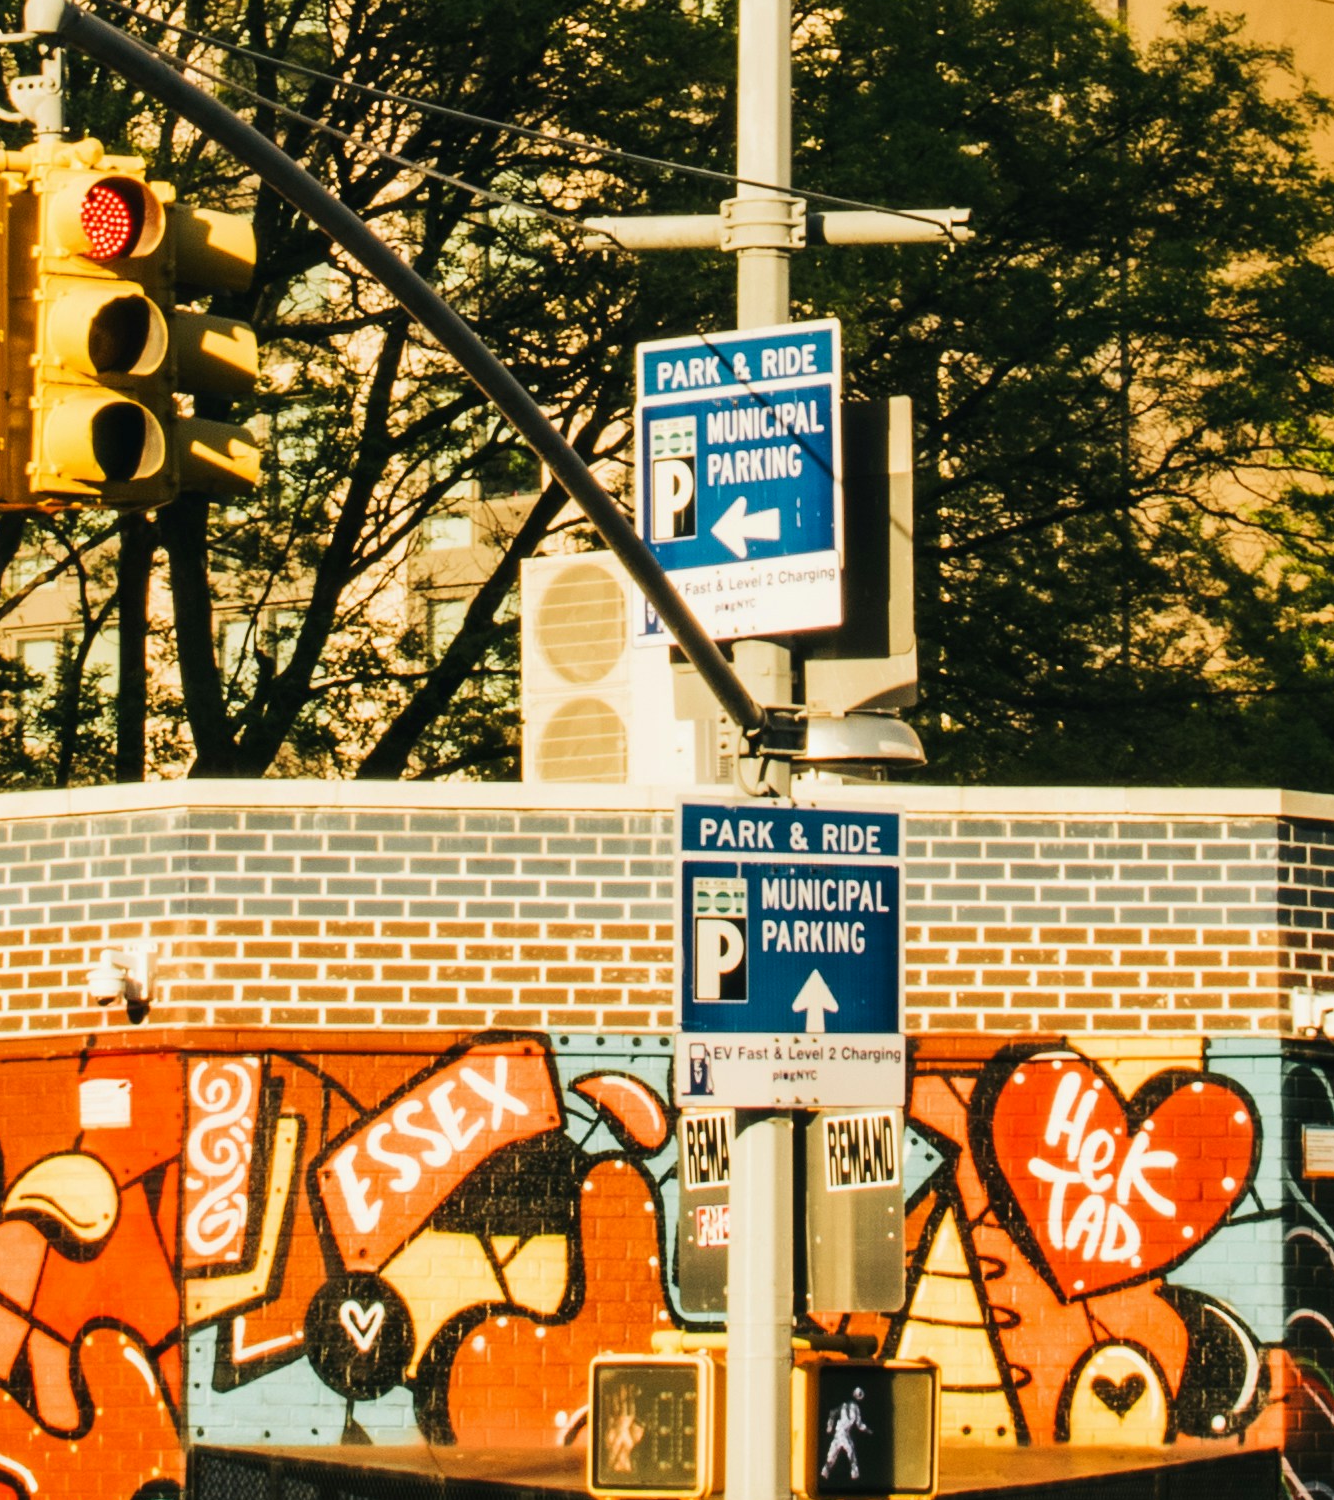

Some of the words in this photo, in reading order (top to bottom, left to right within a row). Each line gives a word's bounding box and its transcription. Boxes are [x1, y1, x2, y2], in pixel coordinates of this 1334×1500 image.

[657, 355, 721, 391] PARK
[732, 352, 752, 381] &
[761, 343, 818, 378] RIDE
[707, 400, 824, 446] MUNICIPAL
[707, 443, 803, 487] PARKING
[684, 581, 711, 597] Fast
[716, 580, 724, 593] &
[729, 574, 762, 591] Level
[767, 572, 774, 586] 2
[778, 567, 836, 588] Charging
[699, 818, 775, 849] PARK
[789, 821, 809, 851] &
[822, 823, 882, 854] RIDE
[761, 878, 890, 913] MUNICIPAL
[761, 919, 867, 954] PARKING
[713, 1046, 733, 1060] EV
[738, 1046, 768, 1060] Fast
[774, 1047, 783, 1060] &
[788, 1046, 824, 1060] Level
[829, 1047, 837, 1060] 2
[841, 1047, 902, 1063] Charging
[329, 1055, 530, 1234] ESSEX
[826, 1115, 895, 1187] REMAND
